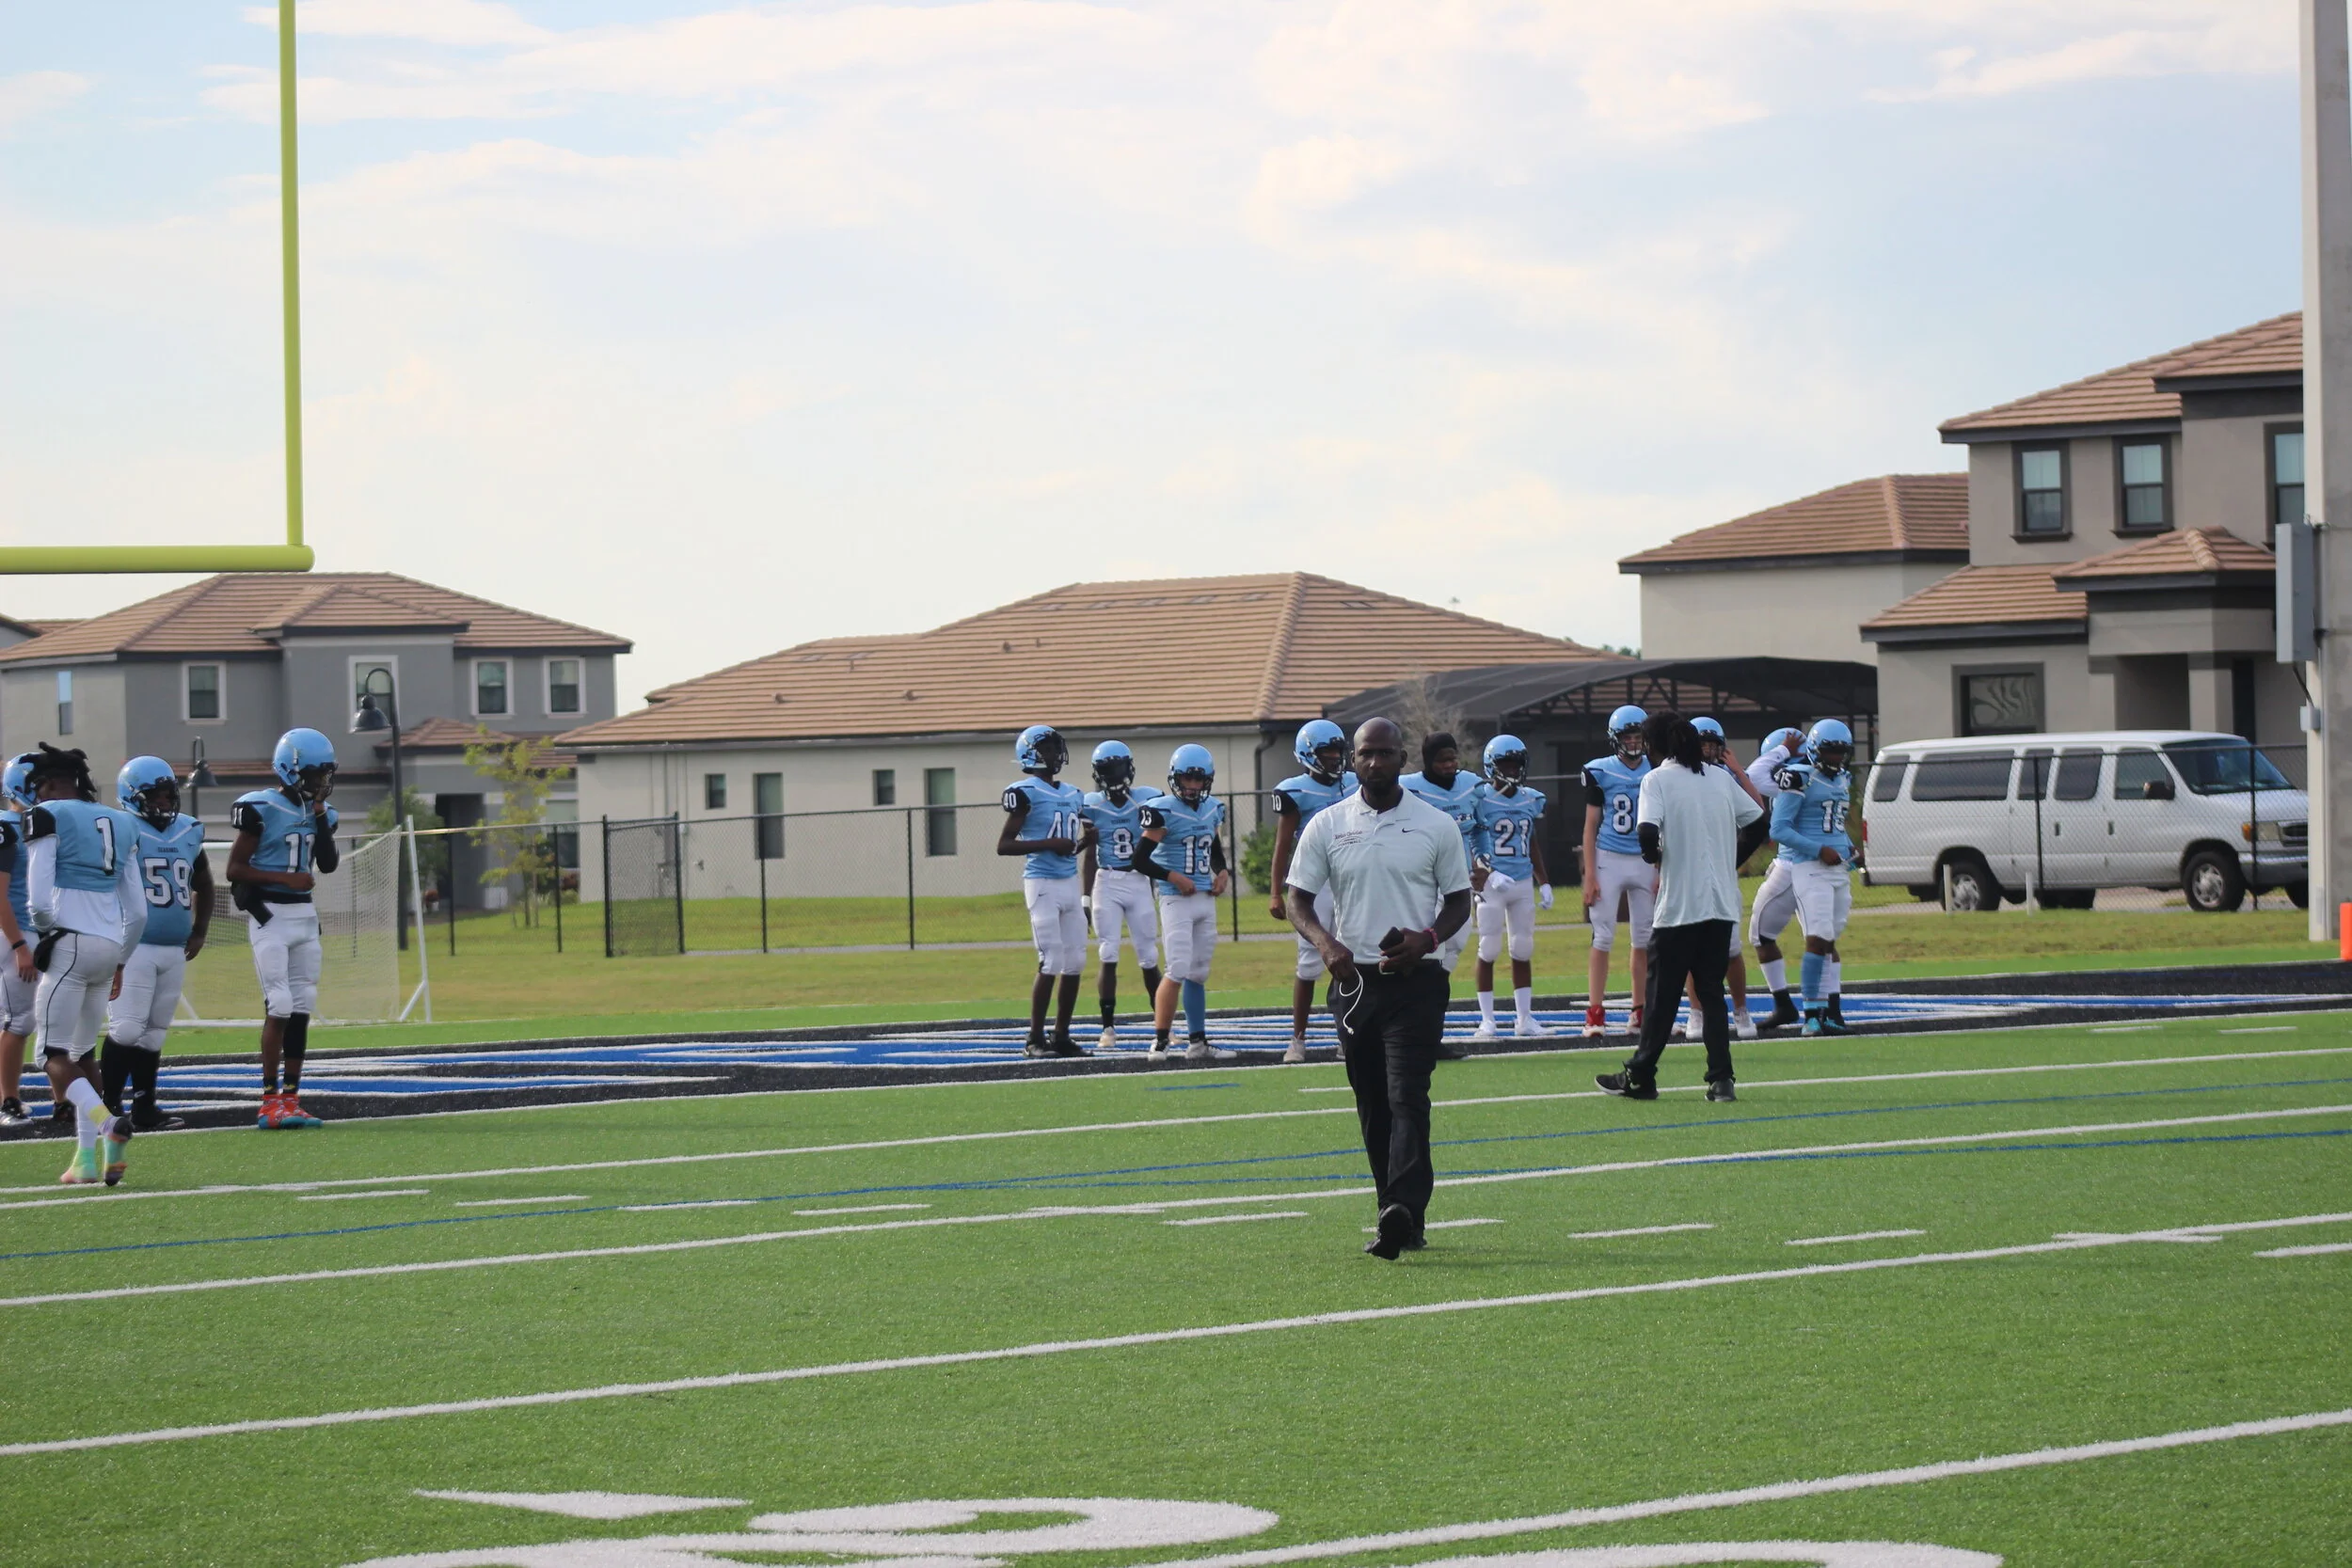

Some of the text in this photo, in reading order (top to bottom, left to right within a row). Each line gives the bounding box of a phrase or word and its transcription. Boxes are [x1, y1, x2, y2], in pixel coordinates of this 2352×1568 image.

[1780, 771, 1793, 788] 15
[233, 807, 245, 826] 11
[1003, 792, 1017, 809] 40
[1271, 794, 1282, 812] 10
[1140, 809, 1152, 826] 13
[95, 816, 116, 876] 1
[284, 832, 317, 873] 11
[1112, 827, 1134, 860] 8
[1495, 816, 1531, 858] 21
[1182, 833, 1213, 875] 13
[144, 857, 193, 910] 59
